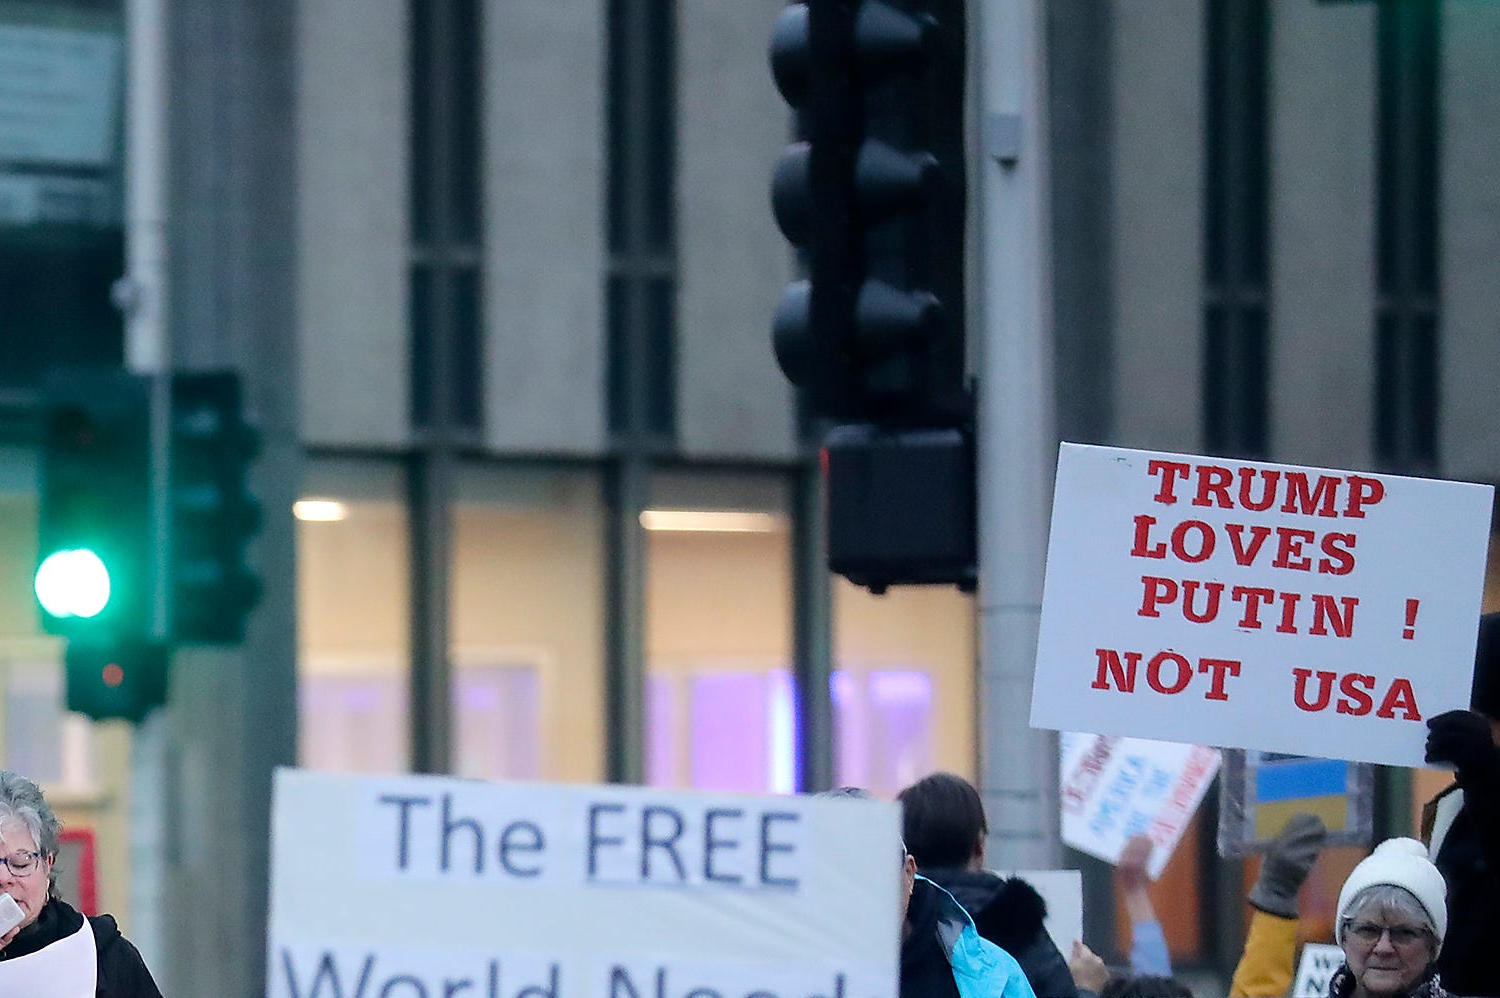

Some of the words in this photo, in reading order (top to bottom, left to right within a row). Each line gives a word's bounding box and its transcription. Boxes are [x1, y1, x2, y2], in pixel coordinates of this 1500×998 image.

[1148, 459, 1386, 519] TRUMP
[1130, 514, 1357, 576] LOVES
[1137, 575, 1360, 638] PUTIN
[1402, 598, 1420, 640] !
[1091, 648, 1242, 701] NOT
[1292, 667, 1422, 722] USA
[376, 793, 547, 878] The
[585, 802, 801, 890] FREE
